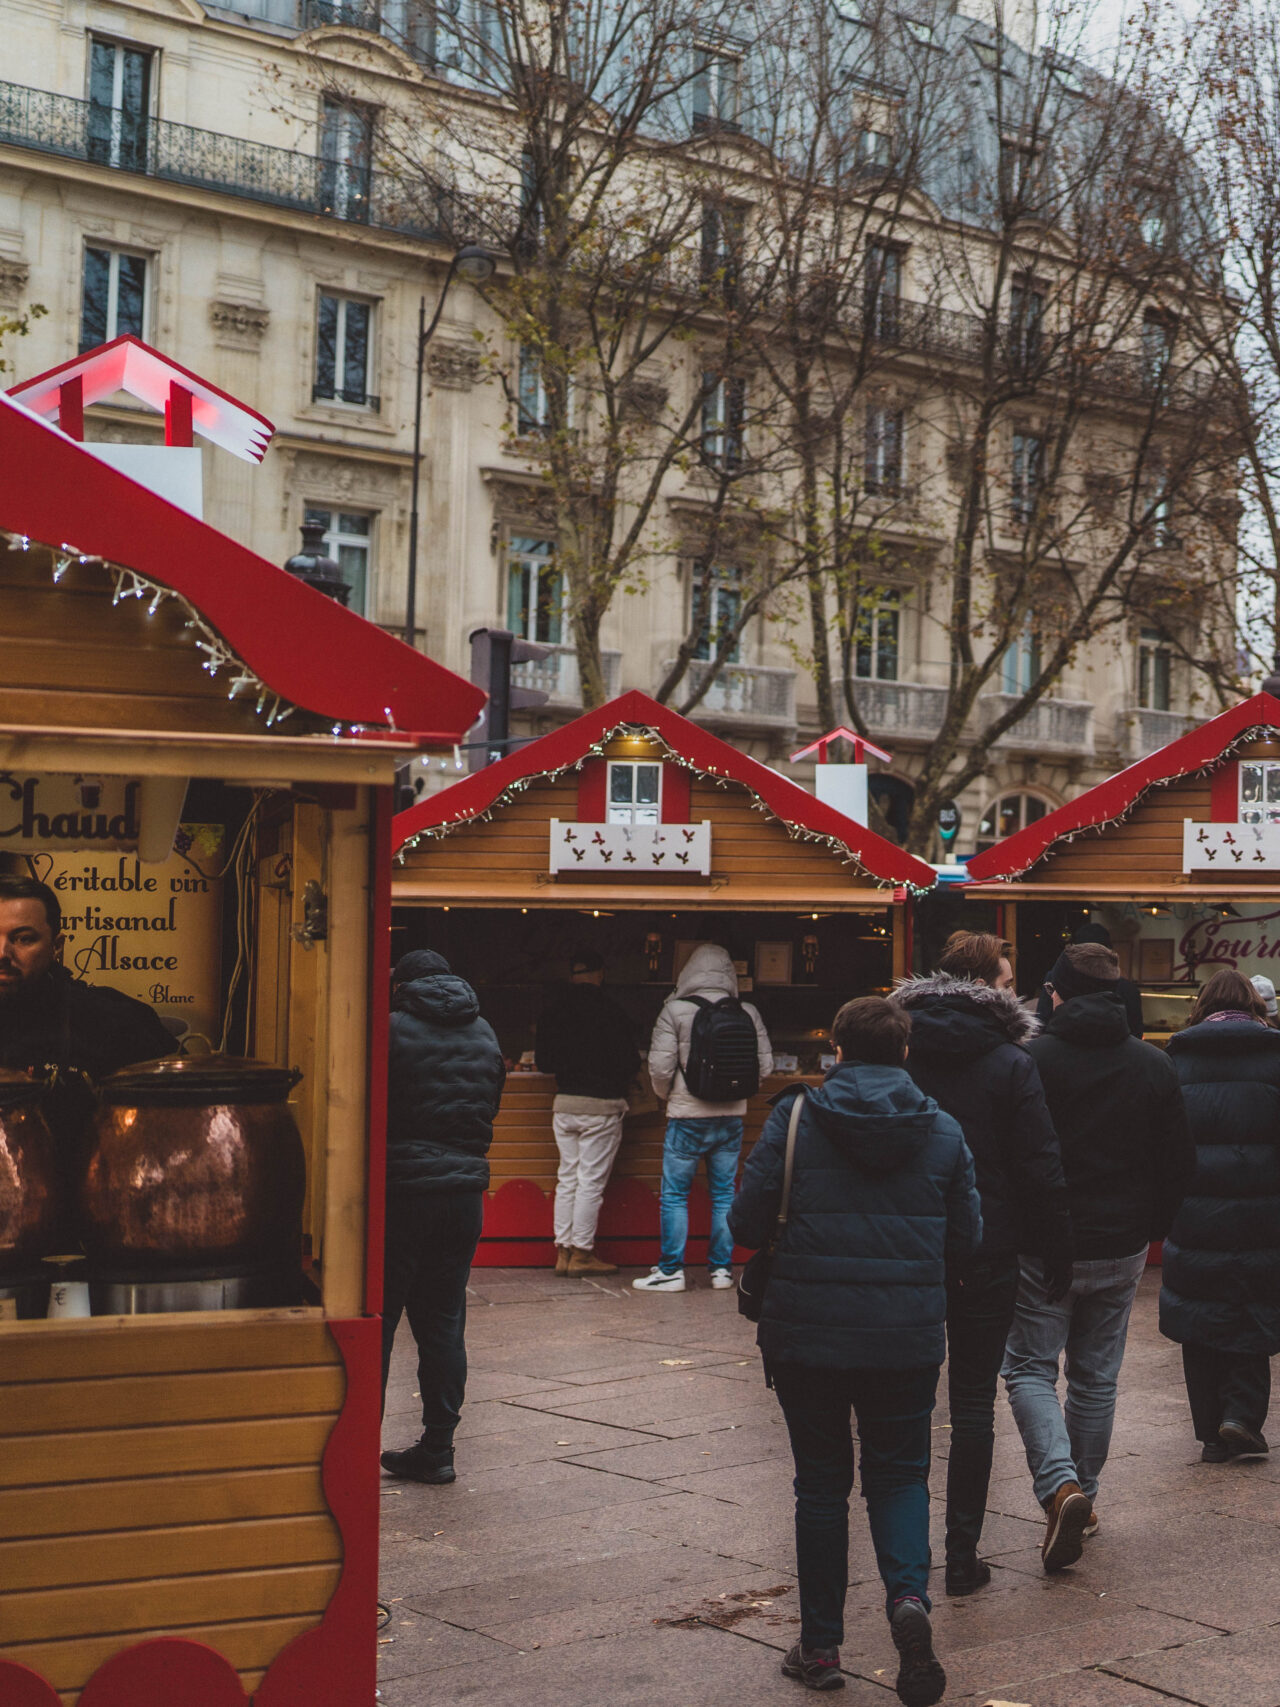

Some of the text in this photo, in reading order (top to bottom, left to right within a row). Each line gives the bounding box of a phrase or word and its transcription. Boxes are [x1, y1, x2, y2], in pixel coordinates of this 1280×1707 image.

[940, 809, 955, 822] BUS
[24, 853, 210, 893] Véritable vin
[60, 897, 177, 931] artisanal
[149, 982, 195, 1003] Blanc
